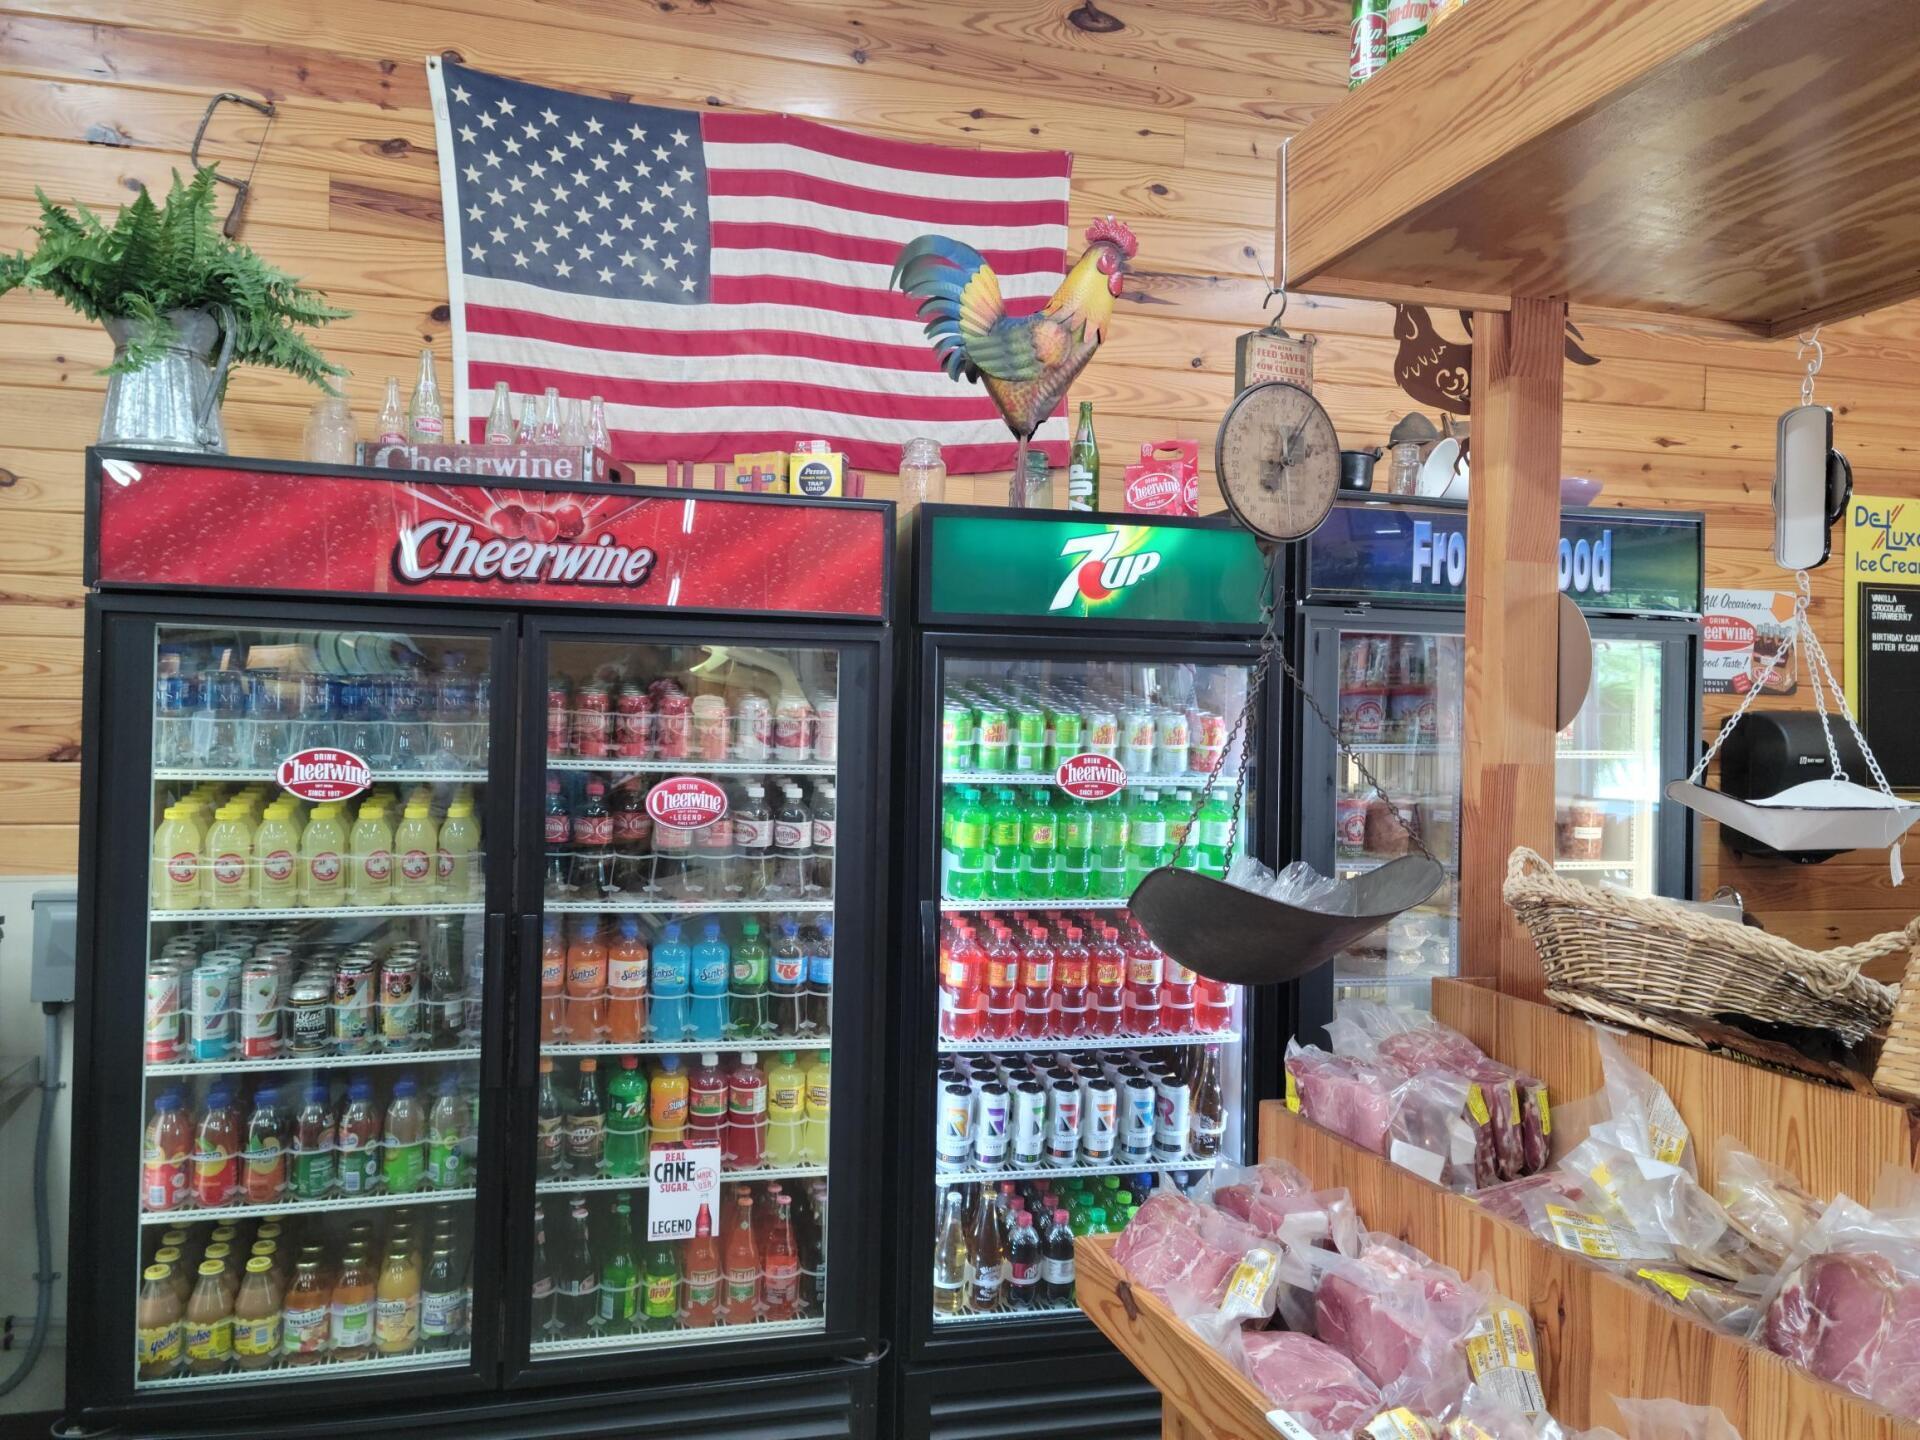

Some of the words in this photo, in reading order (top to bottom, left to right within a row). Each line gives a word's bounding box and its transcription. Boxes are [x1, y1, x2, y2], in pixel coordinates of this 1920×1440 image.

[375, 445, 573, 478] Cheerwine
[1126, 479, 1181, 510] Cheerwine
[396, 518, 656, 584] Cheerwine
[1412, 520, 1466, 587] Fro
[1558, 529, 1612, 593] ood
[1855, 551, 1878, 571] Ice
[1871, 594, 1898, 603] VANILLA
[1871, 604, 1907, 613] CHOCOLATE
[1709, 617, 1730, 625] DRINK
[1871, 612, 1913, 622] STRAWBERRY
[1703, 621, 1754, 641] eerwine
[1871, 632, 1903, 642] BIRTHDAY
[1871, 643, 1896, 652] BUTTER
[1897, 644, 1919, 652] PECAN
[313, 753, 337, 761] DRINK
[278, 759, 371, 786] Cheerwine
[1056, 762, 1129, 787] Cheerwine
[676, 783, 699, 791] DRINK
[307, 789, 327, 797] SINCE
[652, 790, 721, 815] Cheerwine
[673, 813, 703, 821] LEGEND
[664, 1152, 687, 1162] REAL
[653, 1161, 696, 1184] CANE
[660, 1183, 690, 1193] SUGAR.
[651, 1219, 692, 1235] LEGEND
